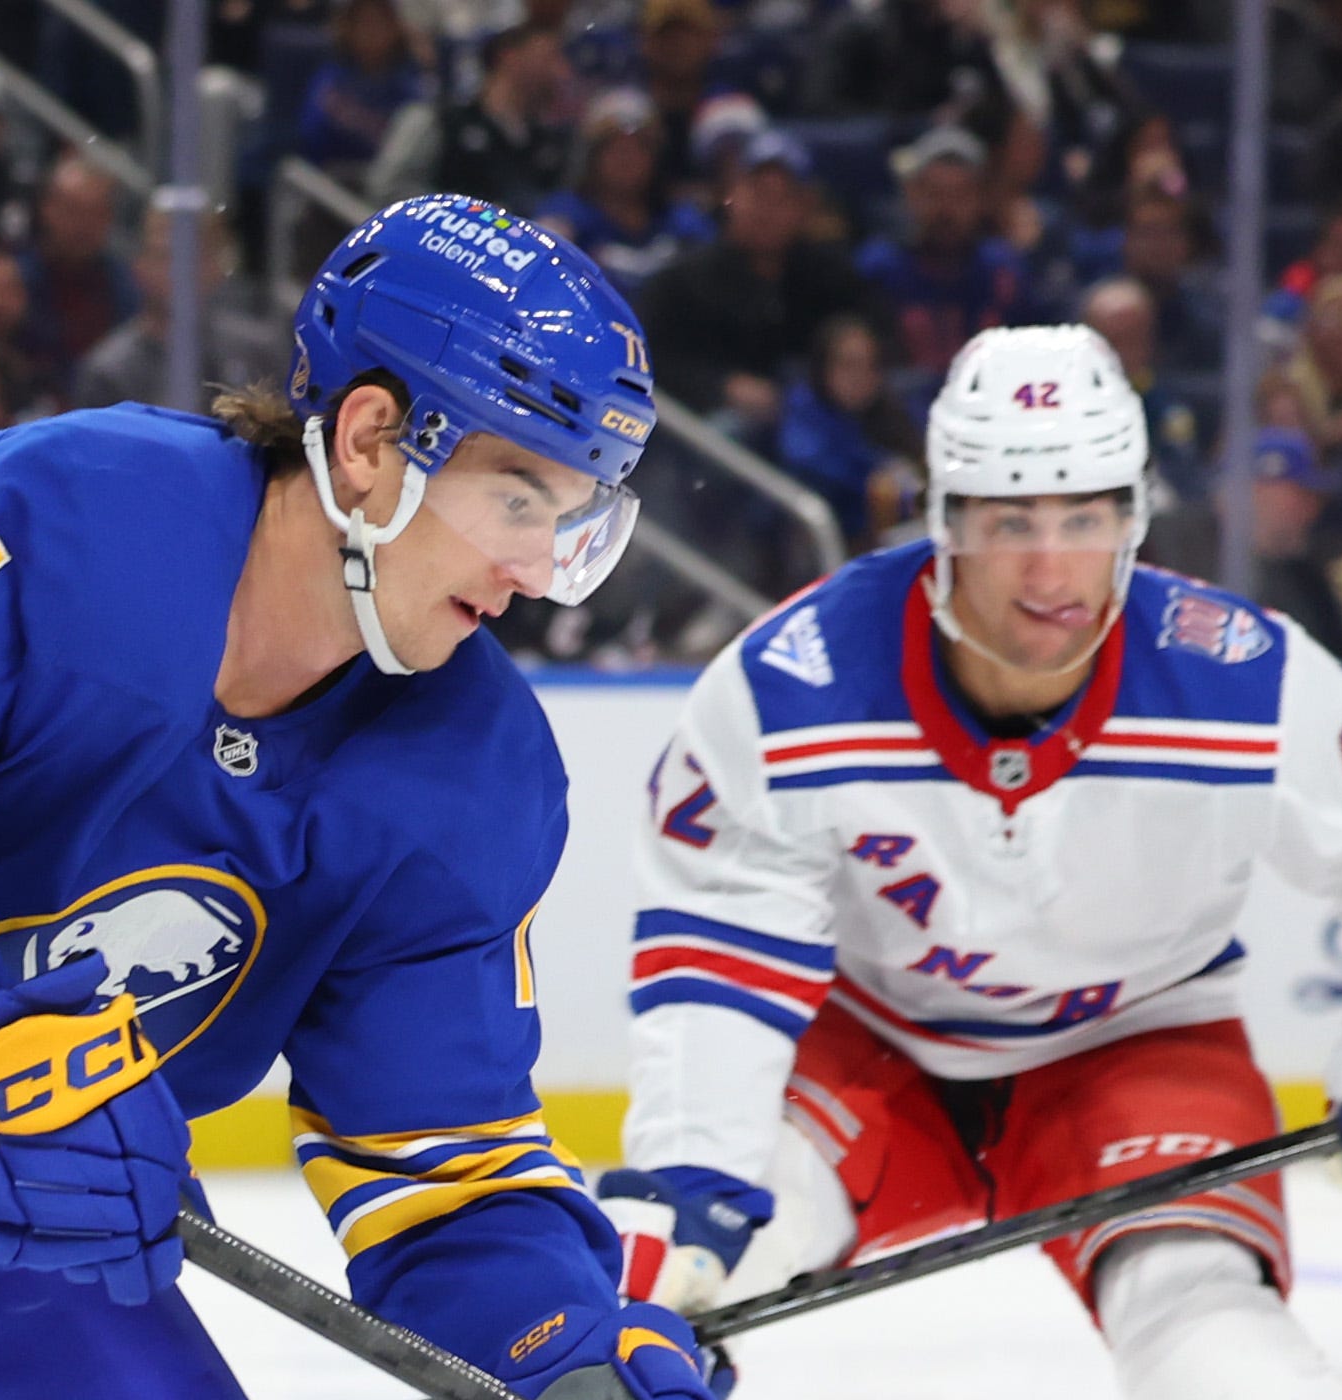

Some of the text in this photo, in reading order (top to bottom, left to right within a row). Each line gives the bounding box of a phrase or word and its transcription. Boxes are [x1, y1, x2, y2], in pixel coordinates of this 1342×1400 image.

[413, 200, 539, 273] Trusted
[418, 229, 487, 270] talent
[1013, 382, 1061, 409] 42
[600, 409, 651, 439] CCM
[647, 733, 719, 848] 2
[509, 1311, 566, 1360] CCM
